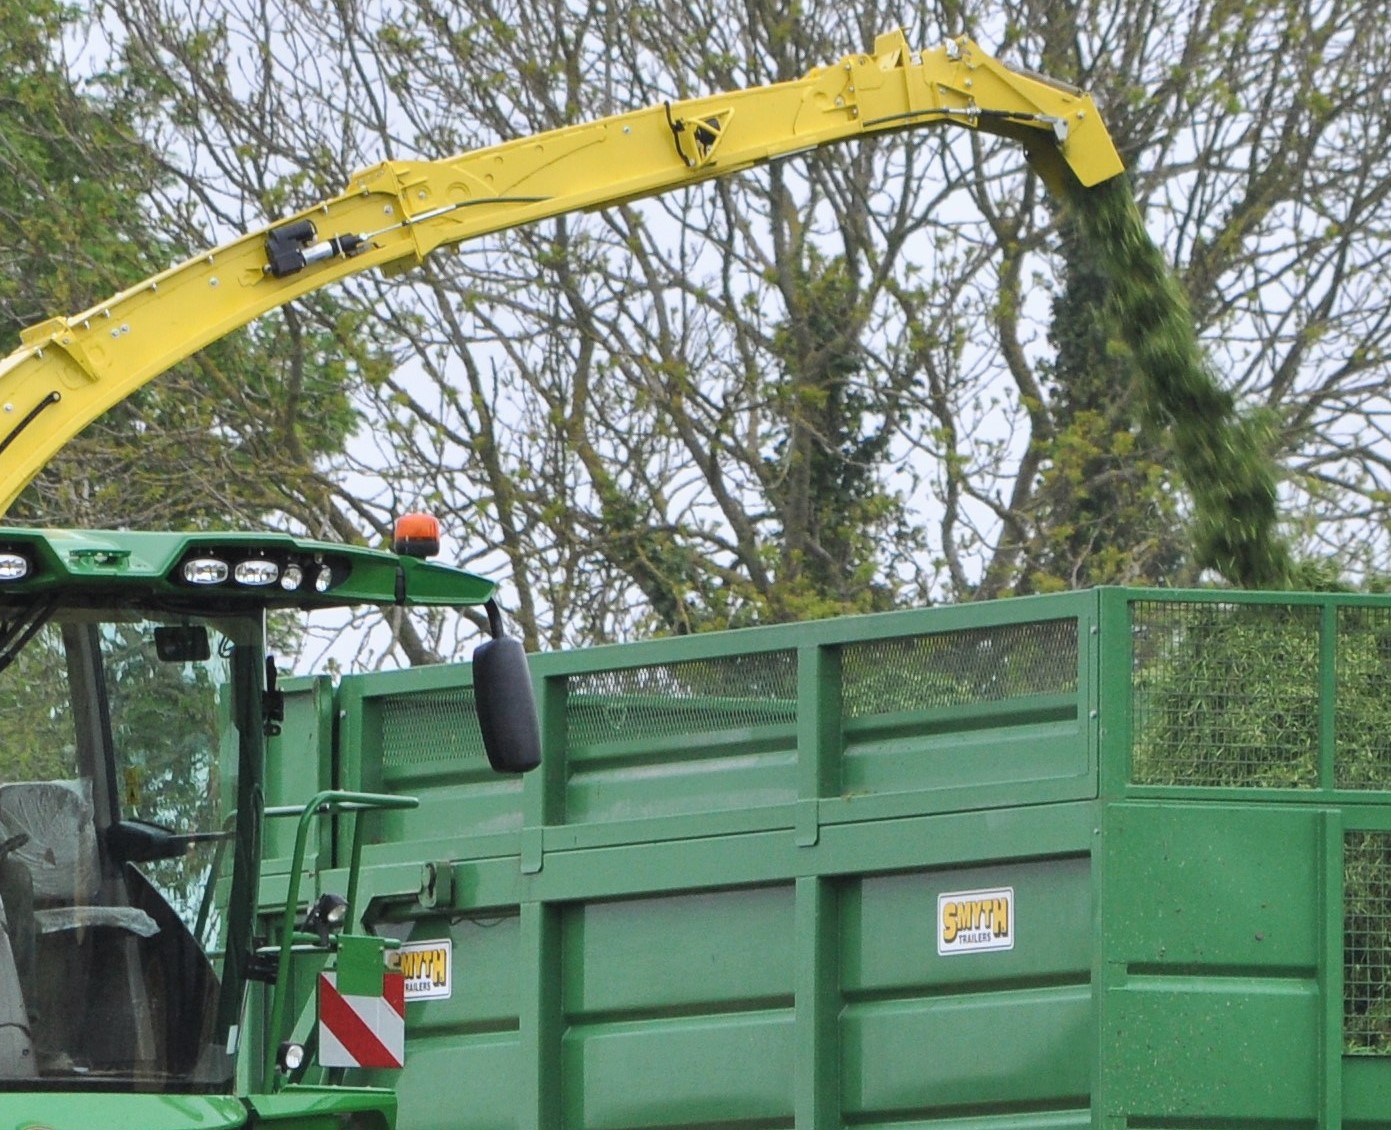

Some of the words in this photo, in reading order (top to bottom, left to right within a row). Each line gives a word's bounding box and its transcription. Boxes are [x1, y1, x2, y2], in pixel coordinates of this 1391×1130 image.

[943, 897, 1008, 943] SMYTH
[958, 931, 992, 945] TRAILERS
[405, 982, 431, 992] RAILERS
